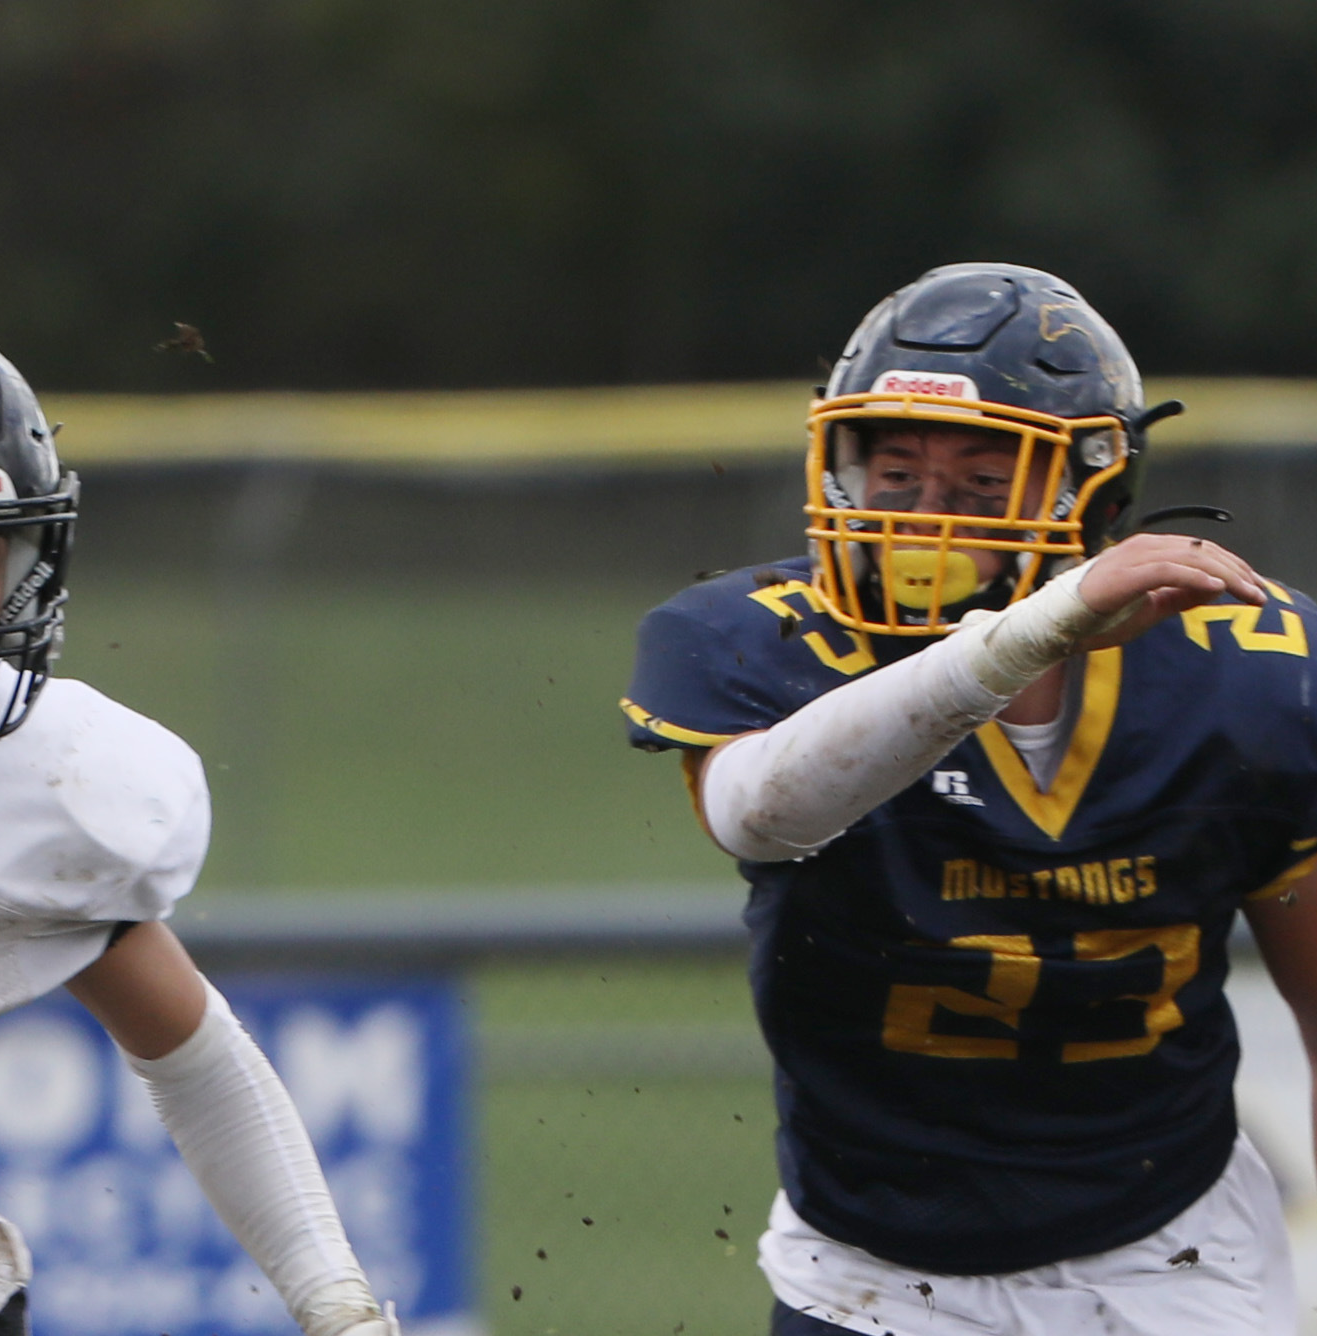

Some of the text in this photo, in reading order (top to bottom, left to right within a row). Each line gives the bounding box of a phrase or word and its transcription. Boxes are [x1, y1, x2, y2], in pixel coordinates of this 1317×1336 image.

[884, 377, 965, 397] Riddell
[941, 855, 1157, 906] MUSTANGS
[883, 924, 1201, 1063] 23
